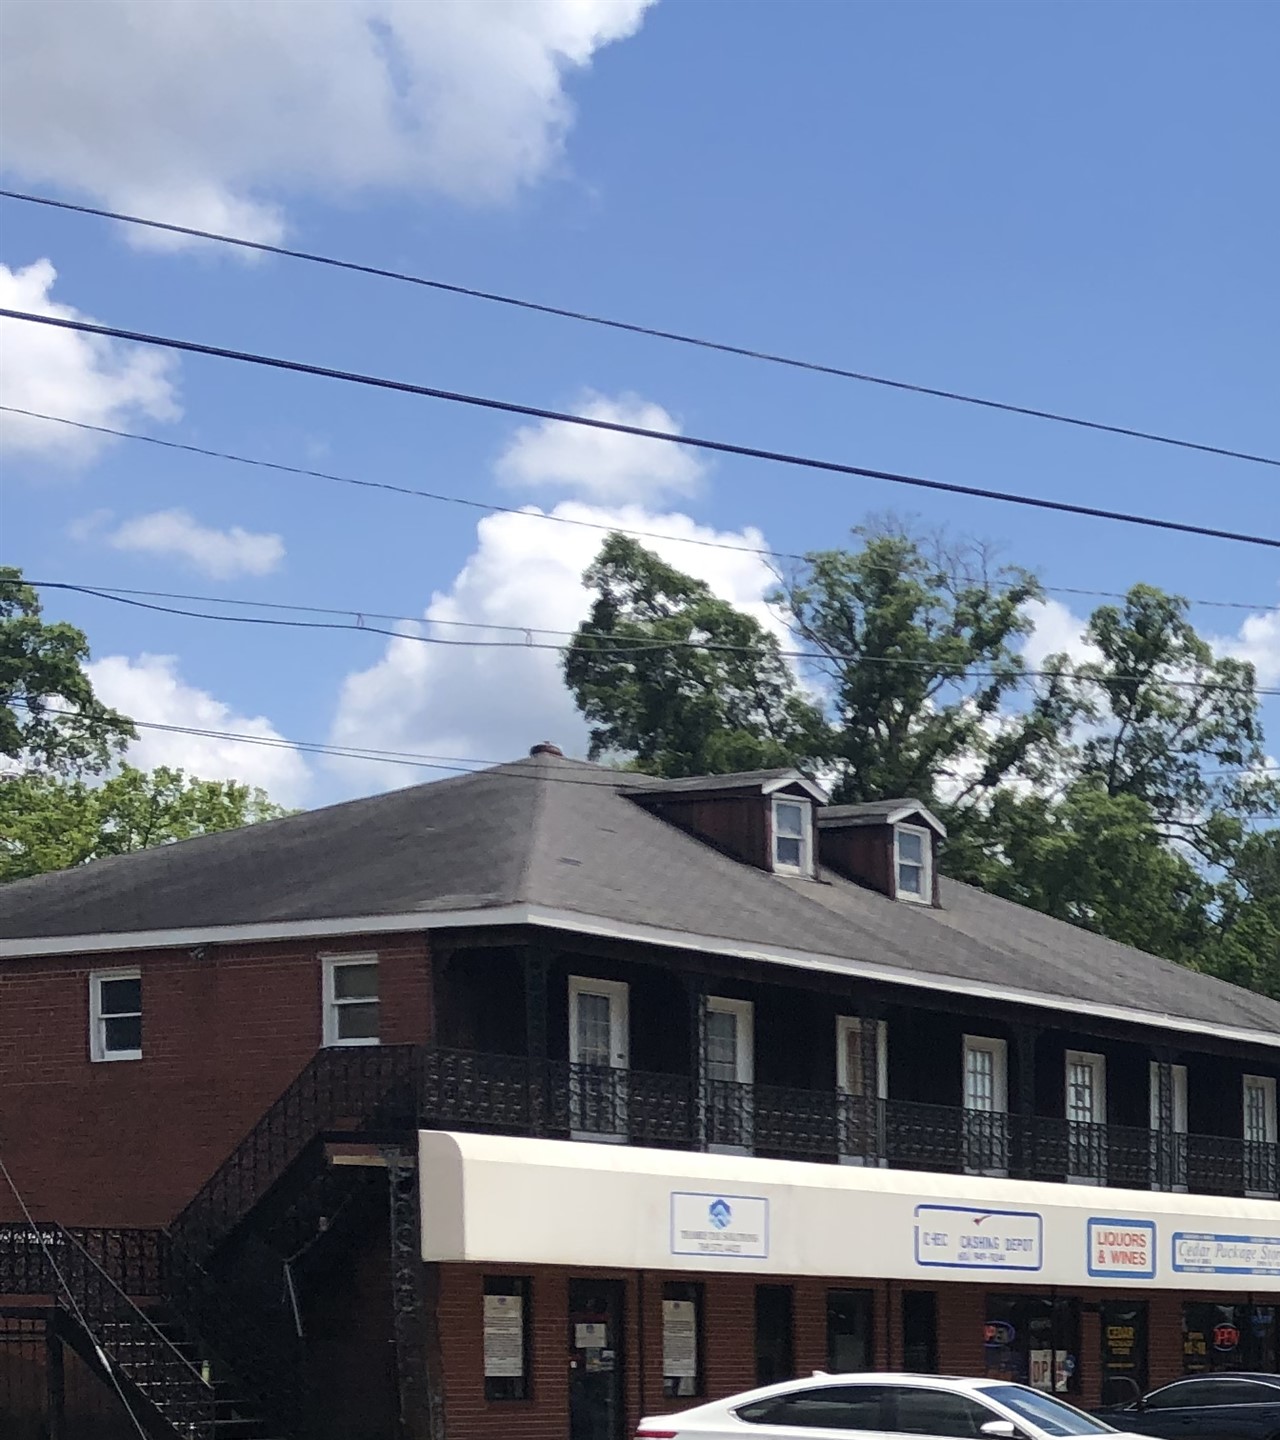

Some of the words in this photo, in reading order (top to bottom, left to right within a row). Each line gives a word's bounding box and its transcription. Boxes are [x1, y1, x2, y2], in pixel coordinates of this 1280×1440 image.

[959, 1235, 1000, 1250] CASHING
[1004, 1238, 1034, 1252] DEPOT
[1097, 1231, 1147, 1248] LIQUORS
[1097, 1249, 1106, 1264] &
[1111, 1250, 1147, 1266] WINES
[1179, 1241, 1211, 1258] Cedar
[1215, 1243, 1257, 1263] Package
